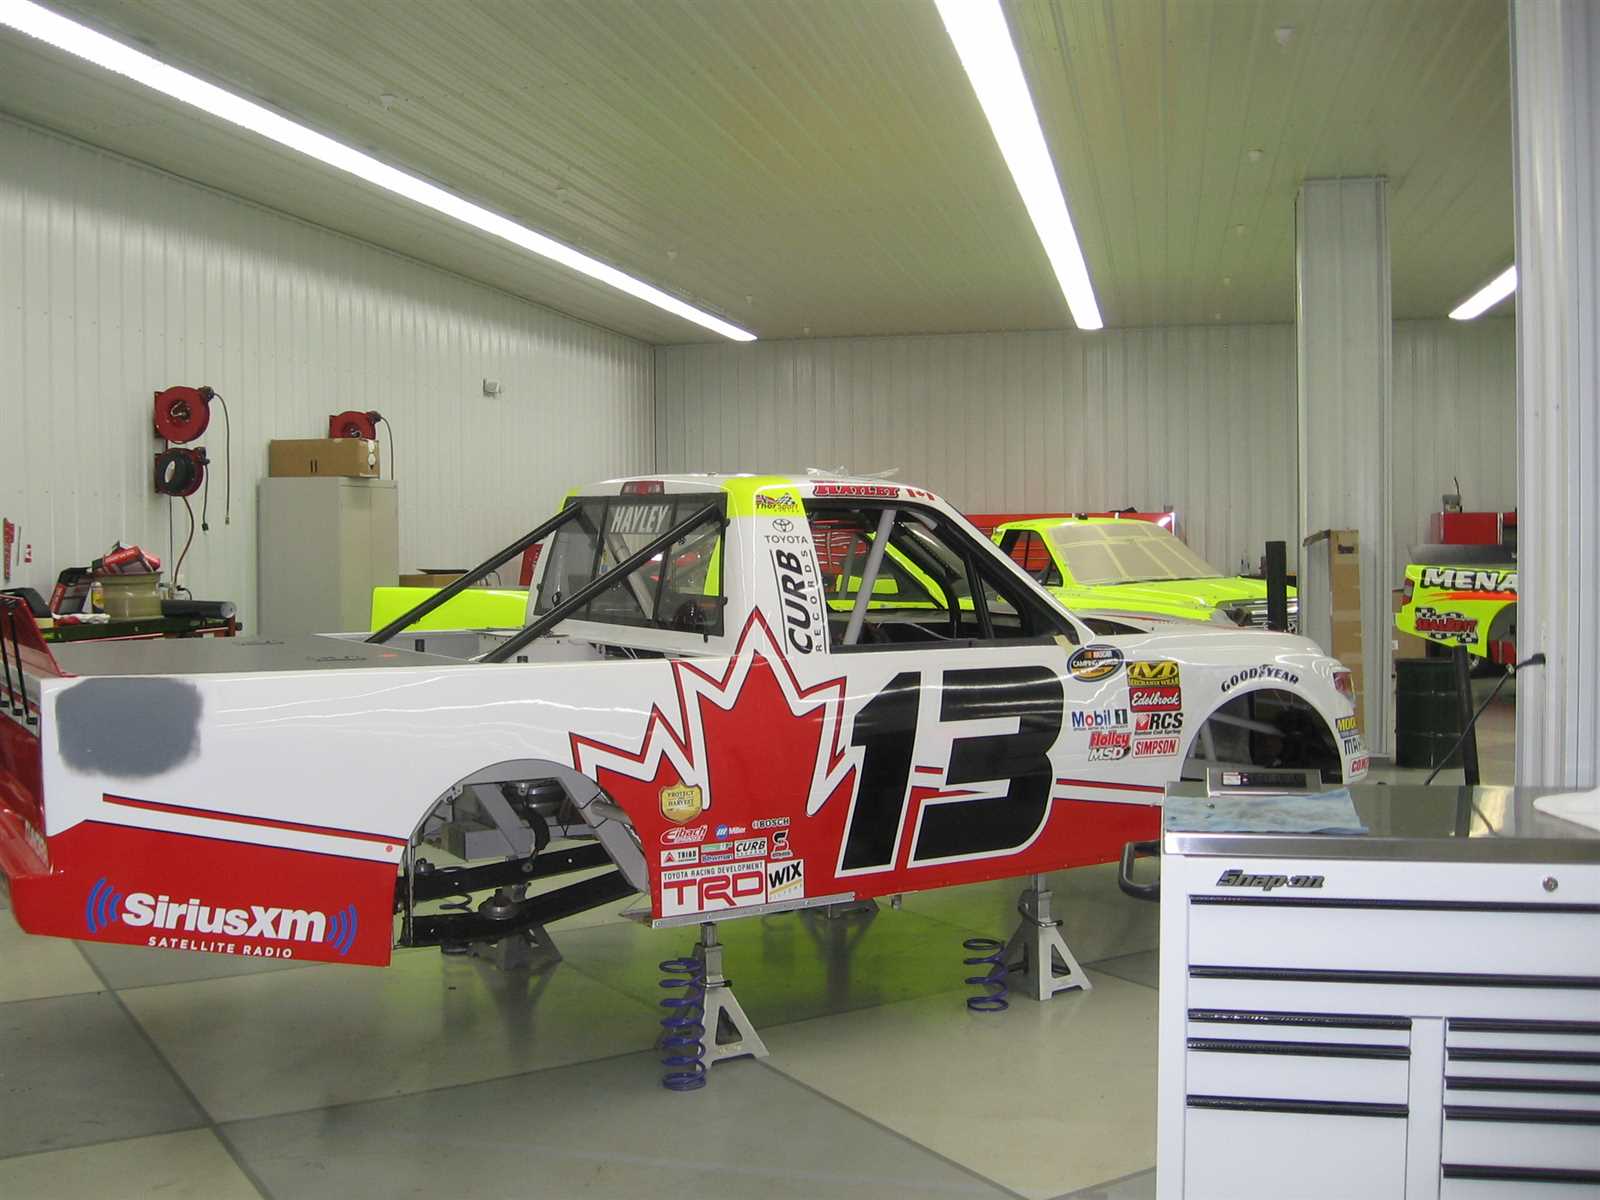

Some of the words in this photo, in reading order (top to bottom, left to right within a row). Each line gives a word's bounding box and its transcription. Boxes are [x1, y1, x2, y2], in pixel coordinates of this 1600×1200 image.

[610, 504, 670, 533] HAYLEY
[764, 535, 809, 544] TOYOTA
[775, 549, 814, 655] CURB
[800, 549, 825, 653] RECORDS
[1220, 664, 1300, 693] GOODYEAR
[1131, 690, 1180, 706] Edelbrock
[1071, 708, 1111, 728] Mobil
[1115, 708, 1128, 724] 1
[1148, 712, 1185, 731] RCS
[1090, 729, 1132, 749] Holley
[1135, 739, 1176, 756] SIMPSON
[1088, 746, 1126, 761] MSD
[836, 665, 1064, 876] 13
[758, 817, 790, 828] BOSCH
[735, 840, 766, 853] CURB
[663, 871, 689, 881] TOYOTA
[690, 867, 716, 877] RACING
[717, 862, 763, 875] DEVELOPMENT
[768, 861, 802, 888] WIX
[1216, 869, 1326, 891] Snap-on
[663, 870, 764, 911] TRD
[148, 936, 236, 954] SATELLITE
[242, 945, 293, 959] RADIO
